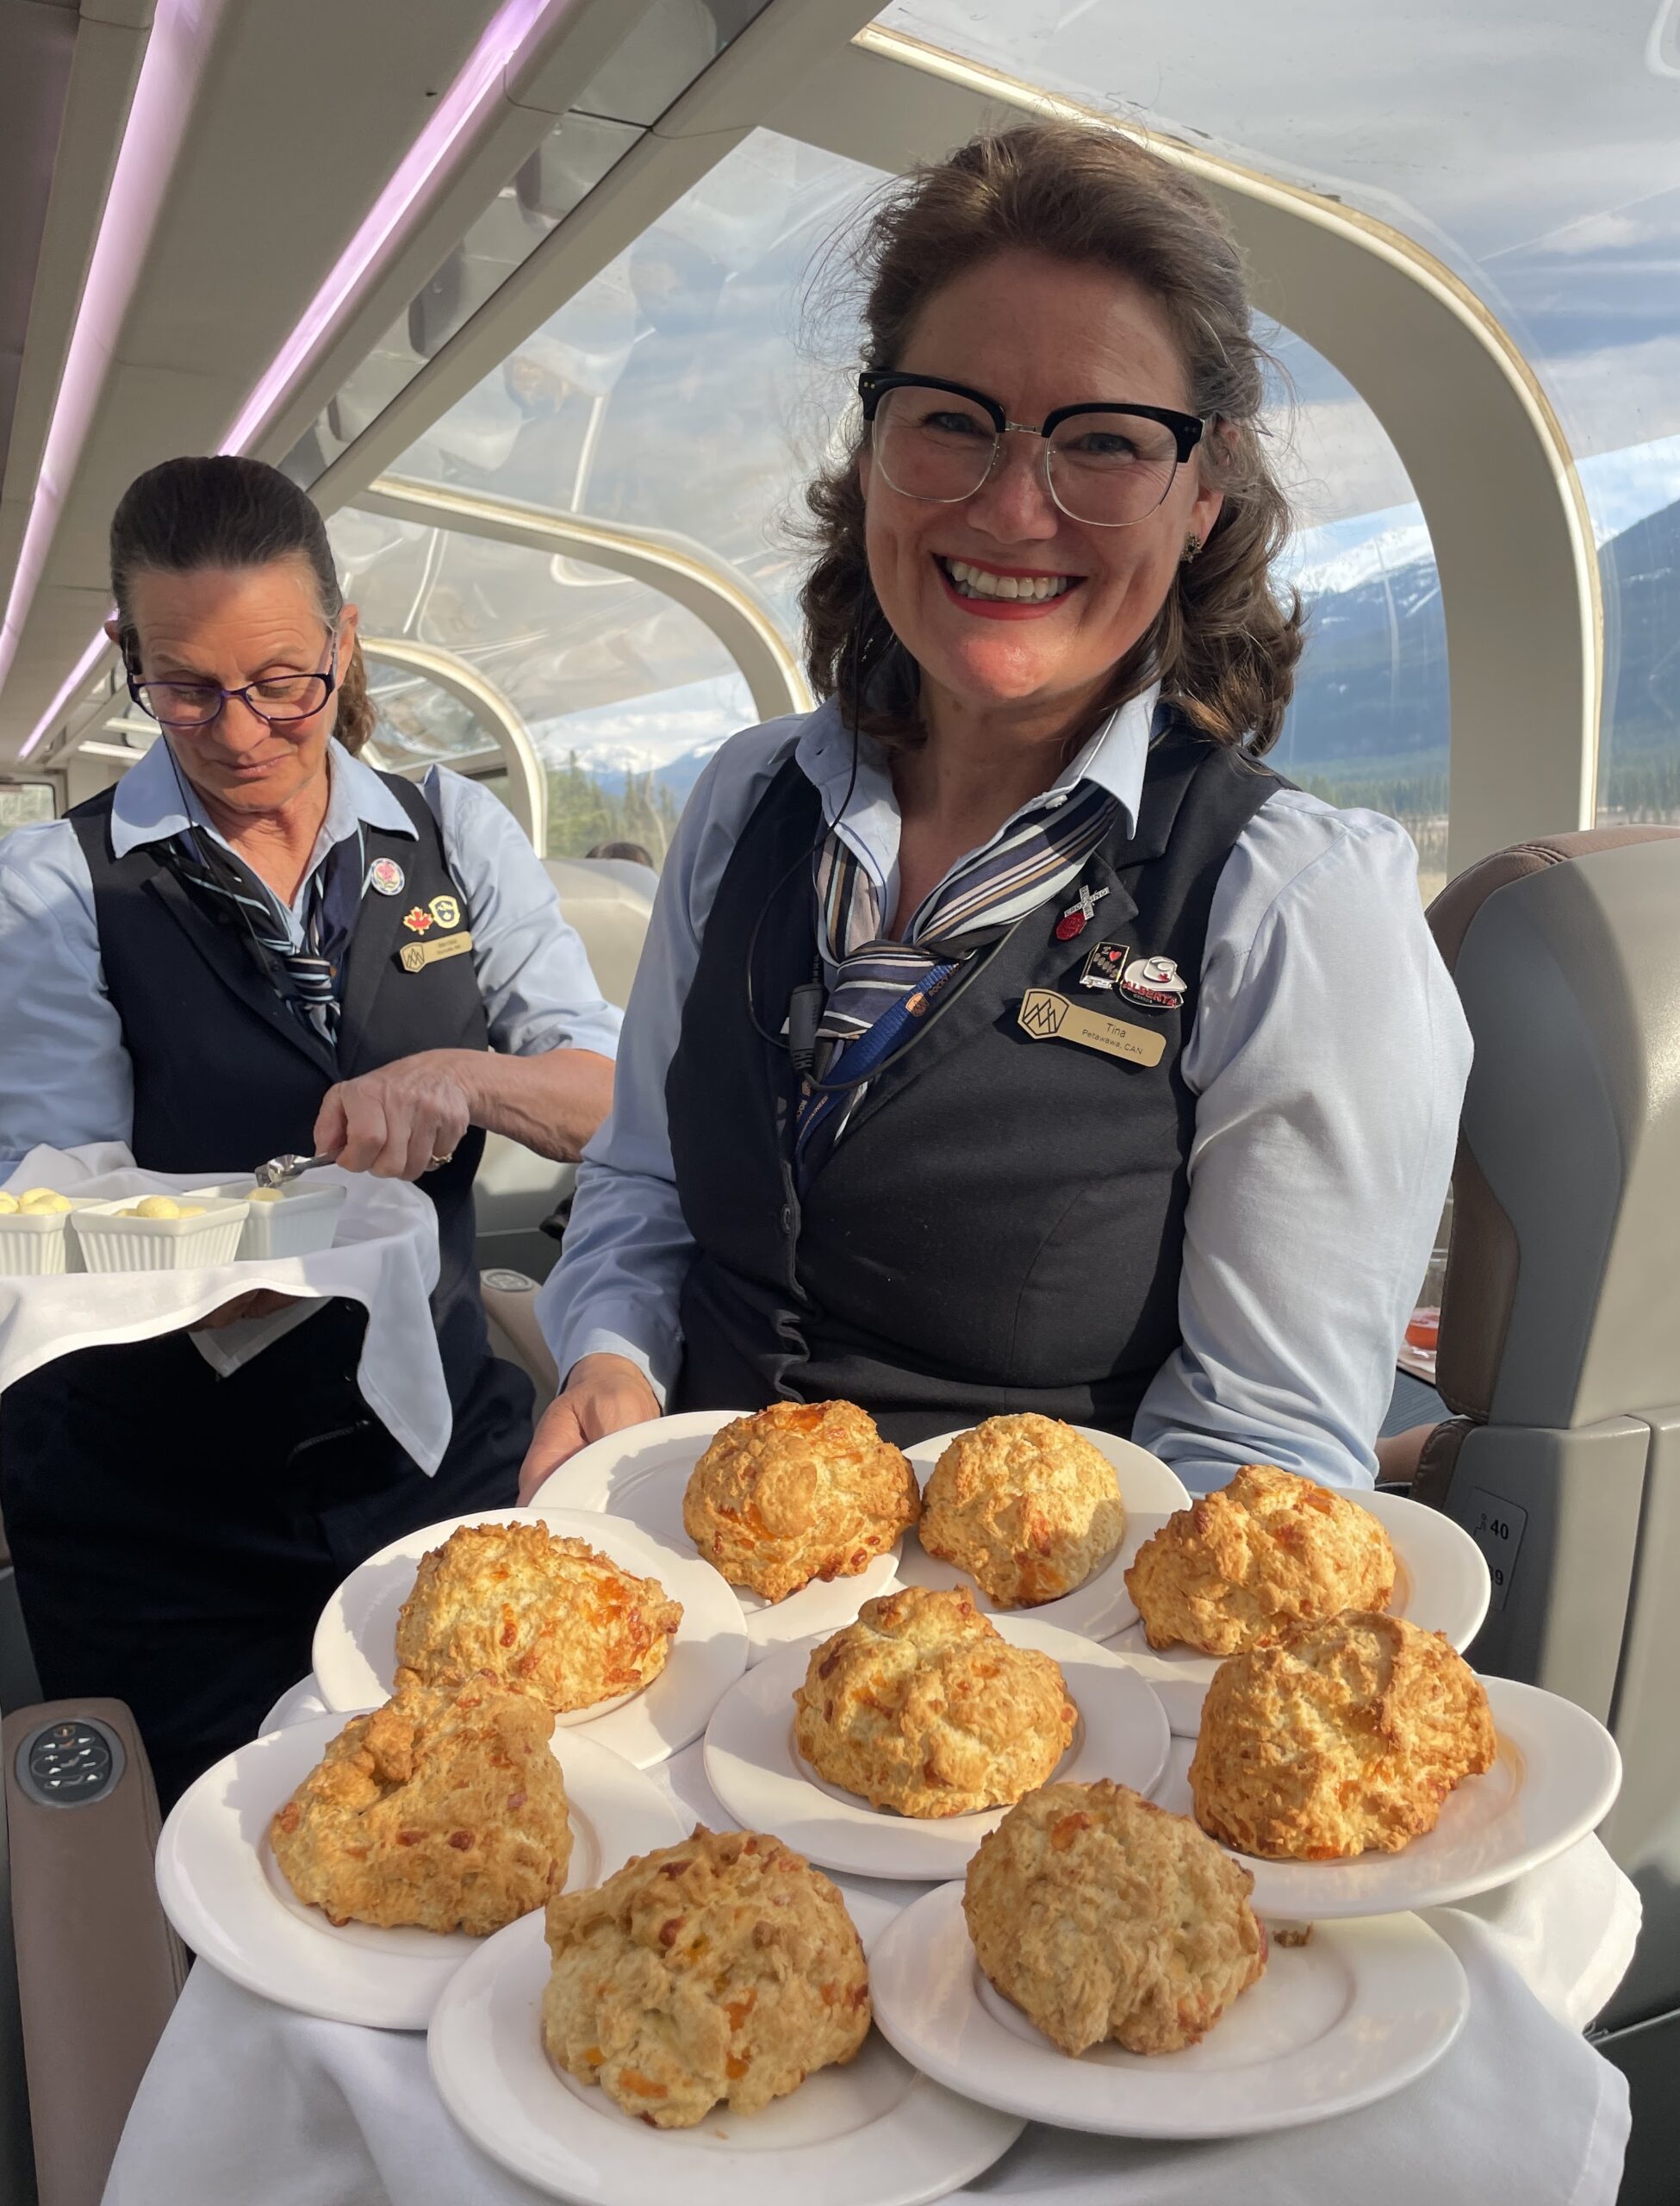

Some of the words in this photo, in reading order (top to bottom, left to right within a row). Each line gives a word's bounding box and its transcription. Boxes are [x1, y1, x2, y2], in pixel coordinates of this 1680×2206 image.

[1122, 981, 1177, 1007] ALBERTA
[1106, 1022, 1127, 1038] Tina
[1123, 1043, 1143, 1056] CAN
[1490, 1519, 1509, 1540] 40
